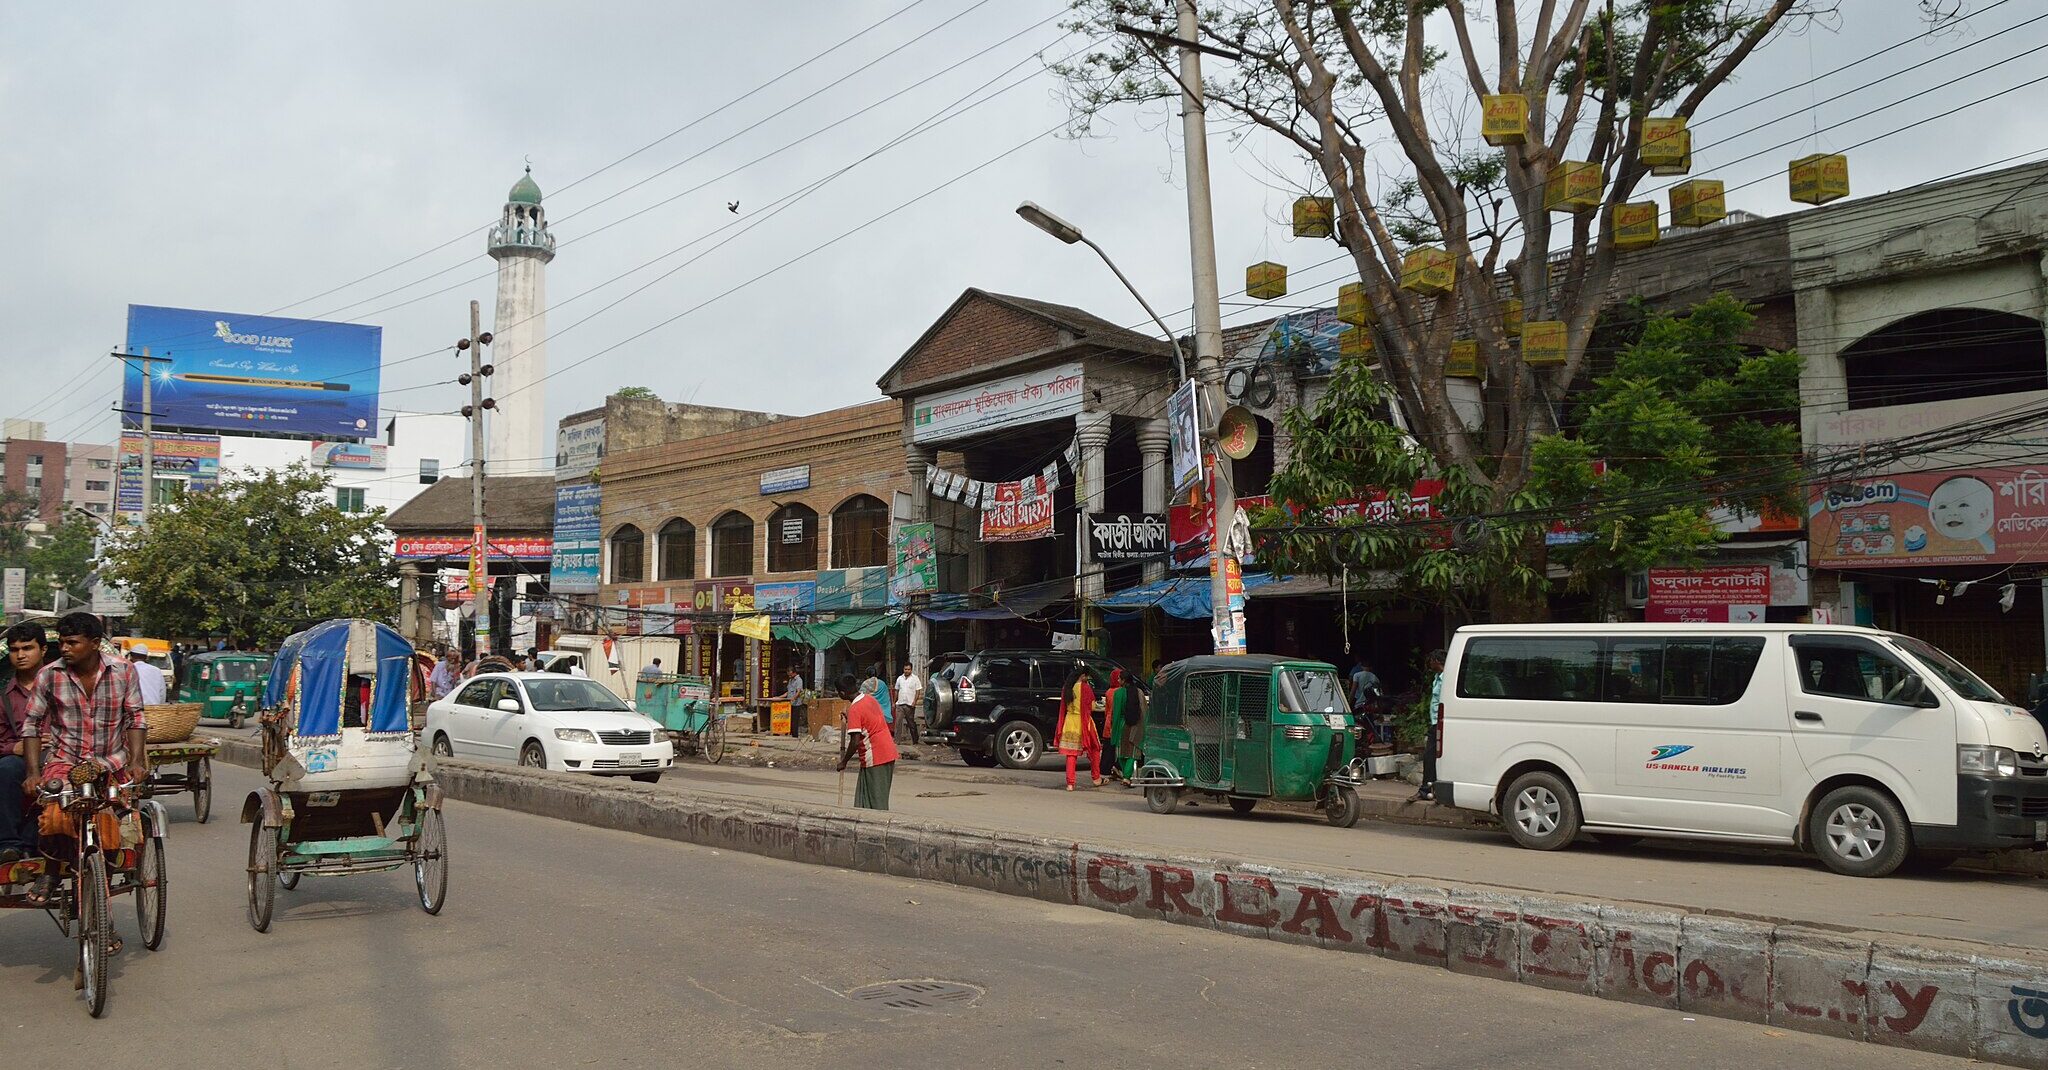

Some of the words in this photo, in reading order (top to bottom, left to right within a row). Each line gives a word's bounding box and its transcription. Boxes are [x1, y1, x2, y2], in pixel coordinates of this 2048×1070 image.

[223, 333, 260, 345] GOOD
[260, 335, 294, 348] LUCK
[933, 396, 972, 419] বাংলাদেশ
[974, 389, 1018, 414] মুক্তিযোদ্ধা
[1021, 382, 1043, 401] ঐক্য
[1047, 374, 1082, 396] পরিষদ
[1093, 514, 1132, 550] কাজী
[1133, 515, 1167, 549] অফিস
[1651, 572, 1768, 589] অনুবাদ-নোটারী
[1645, 763, 1699, 772] US-BANGLA
[1701, 766, 1747, 774] AIRLINES
